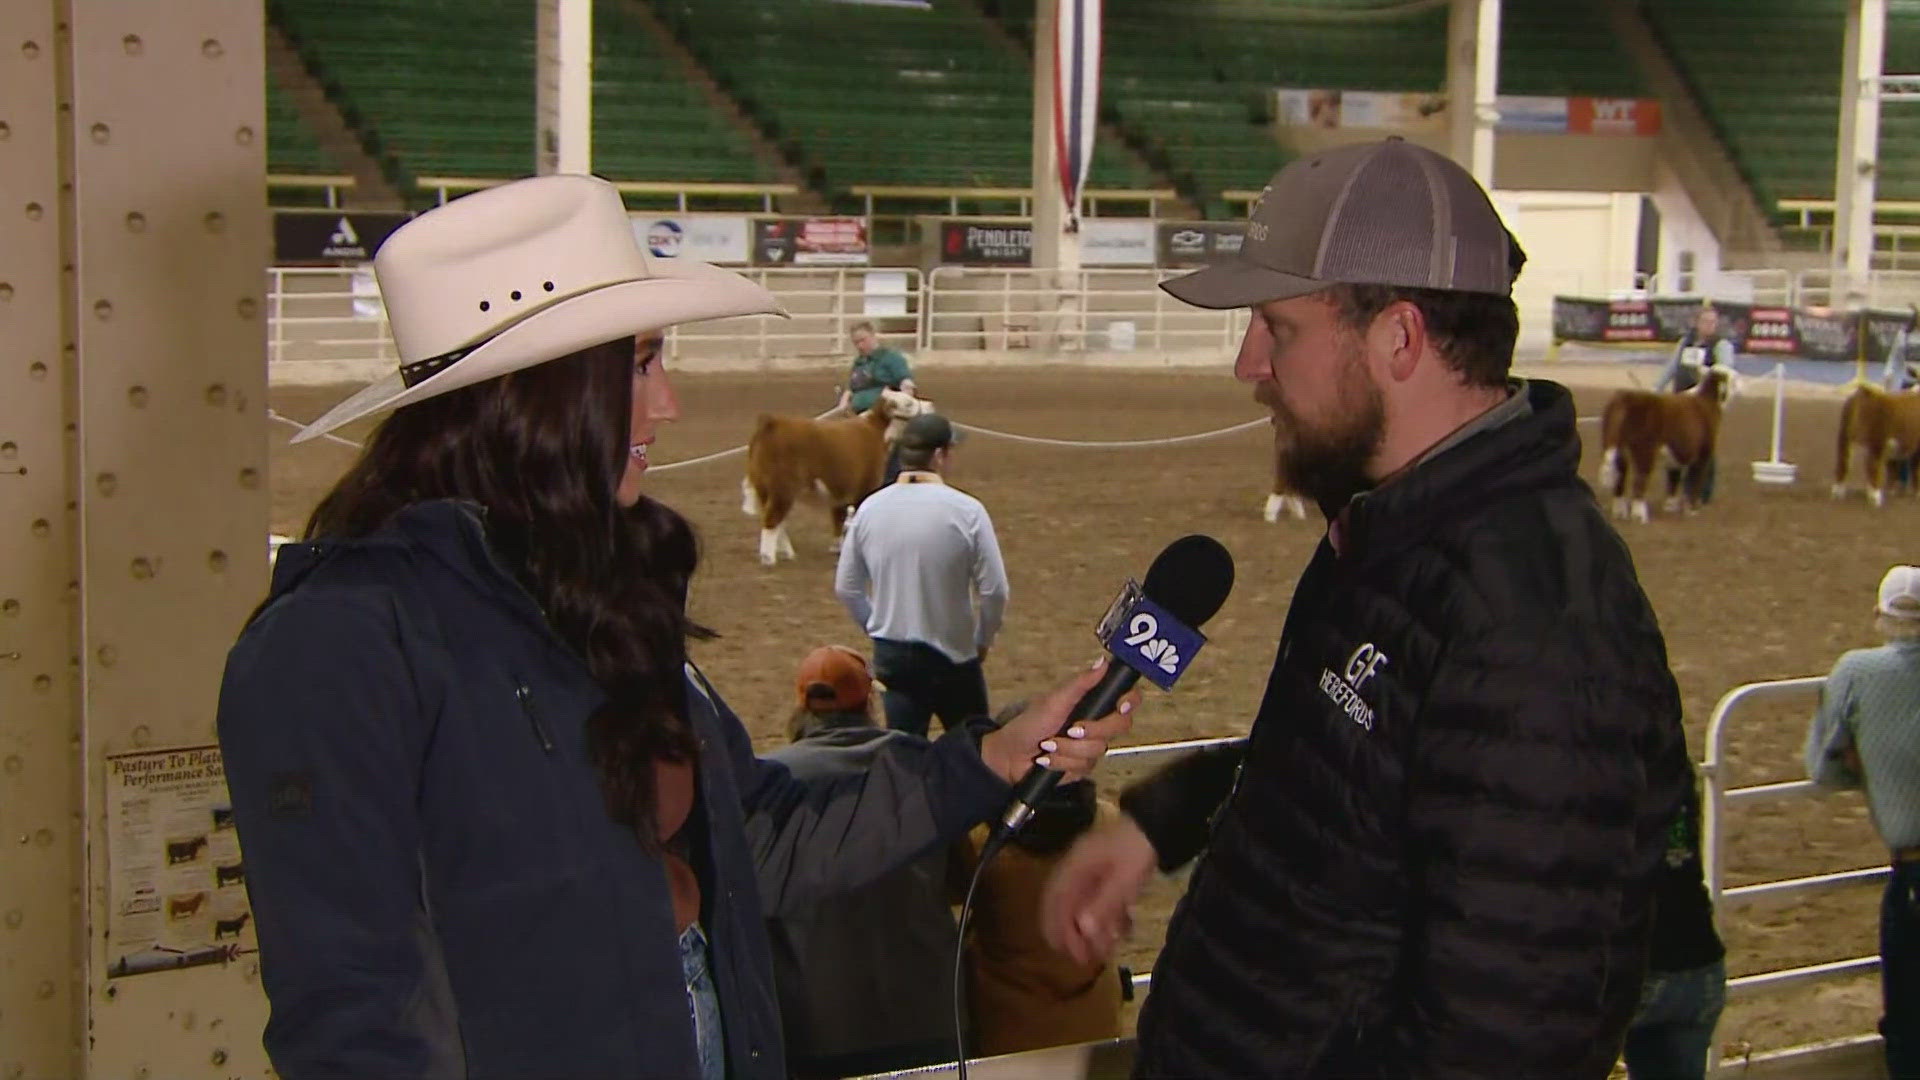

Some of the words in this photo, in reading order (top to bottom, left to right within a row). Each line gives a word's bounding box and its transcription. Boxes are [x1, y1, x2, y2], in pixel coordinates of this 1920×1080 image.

[967, 226, 1032, 248] PENDLETO
[1123, 612, 1158, 647] 9
[1344, 642, 1389, 690] GF
[1318, 667, 1375, 731] HEREFORDS
[114, 758, 165, 776] Pasture
[169, 754, 185, 769] To
[122, 767, 204, 789] Performance
